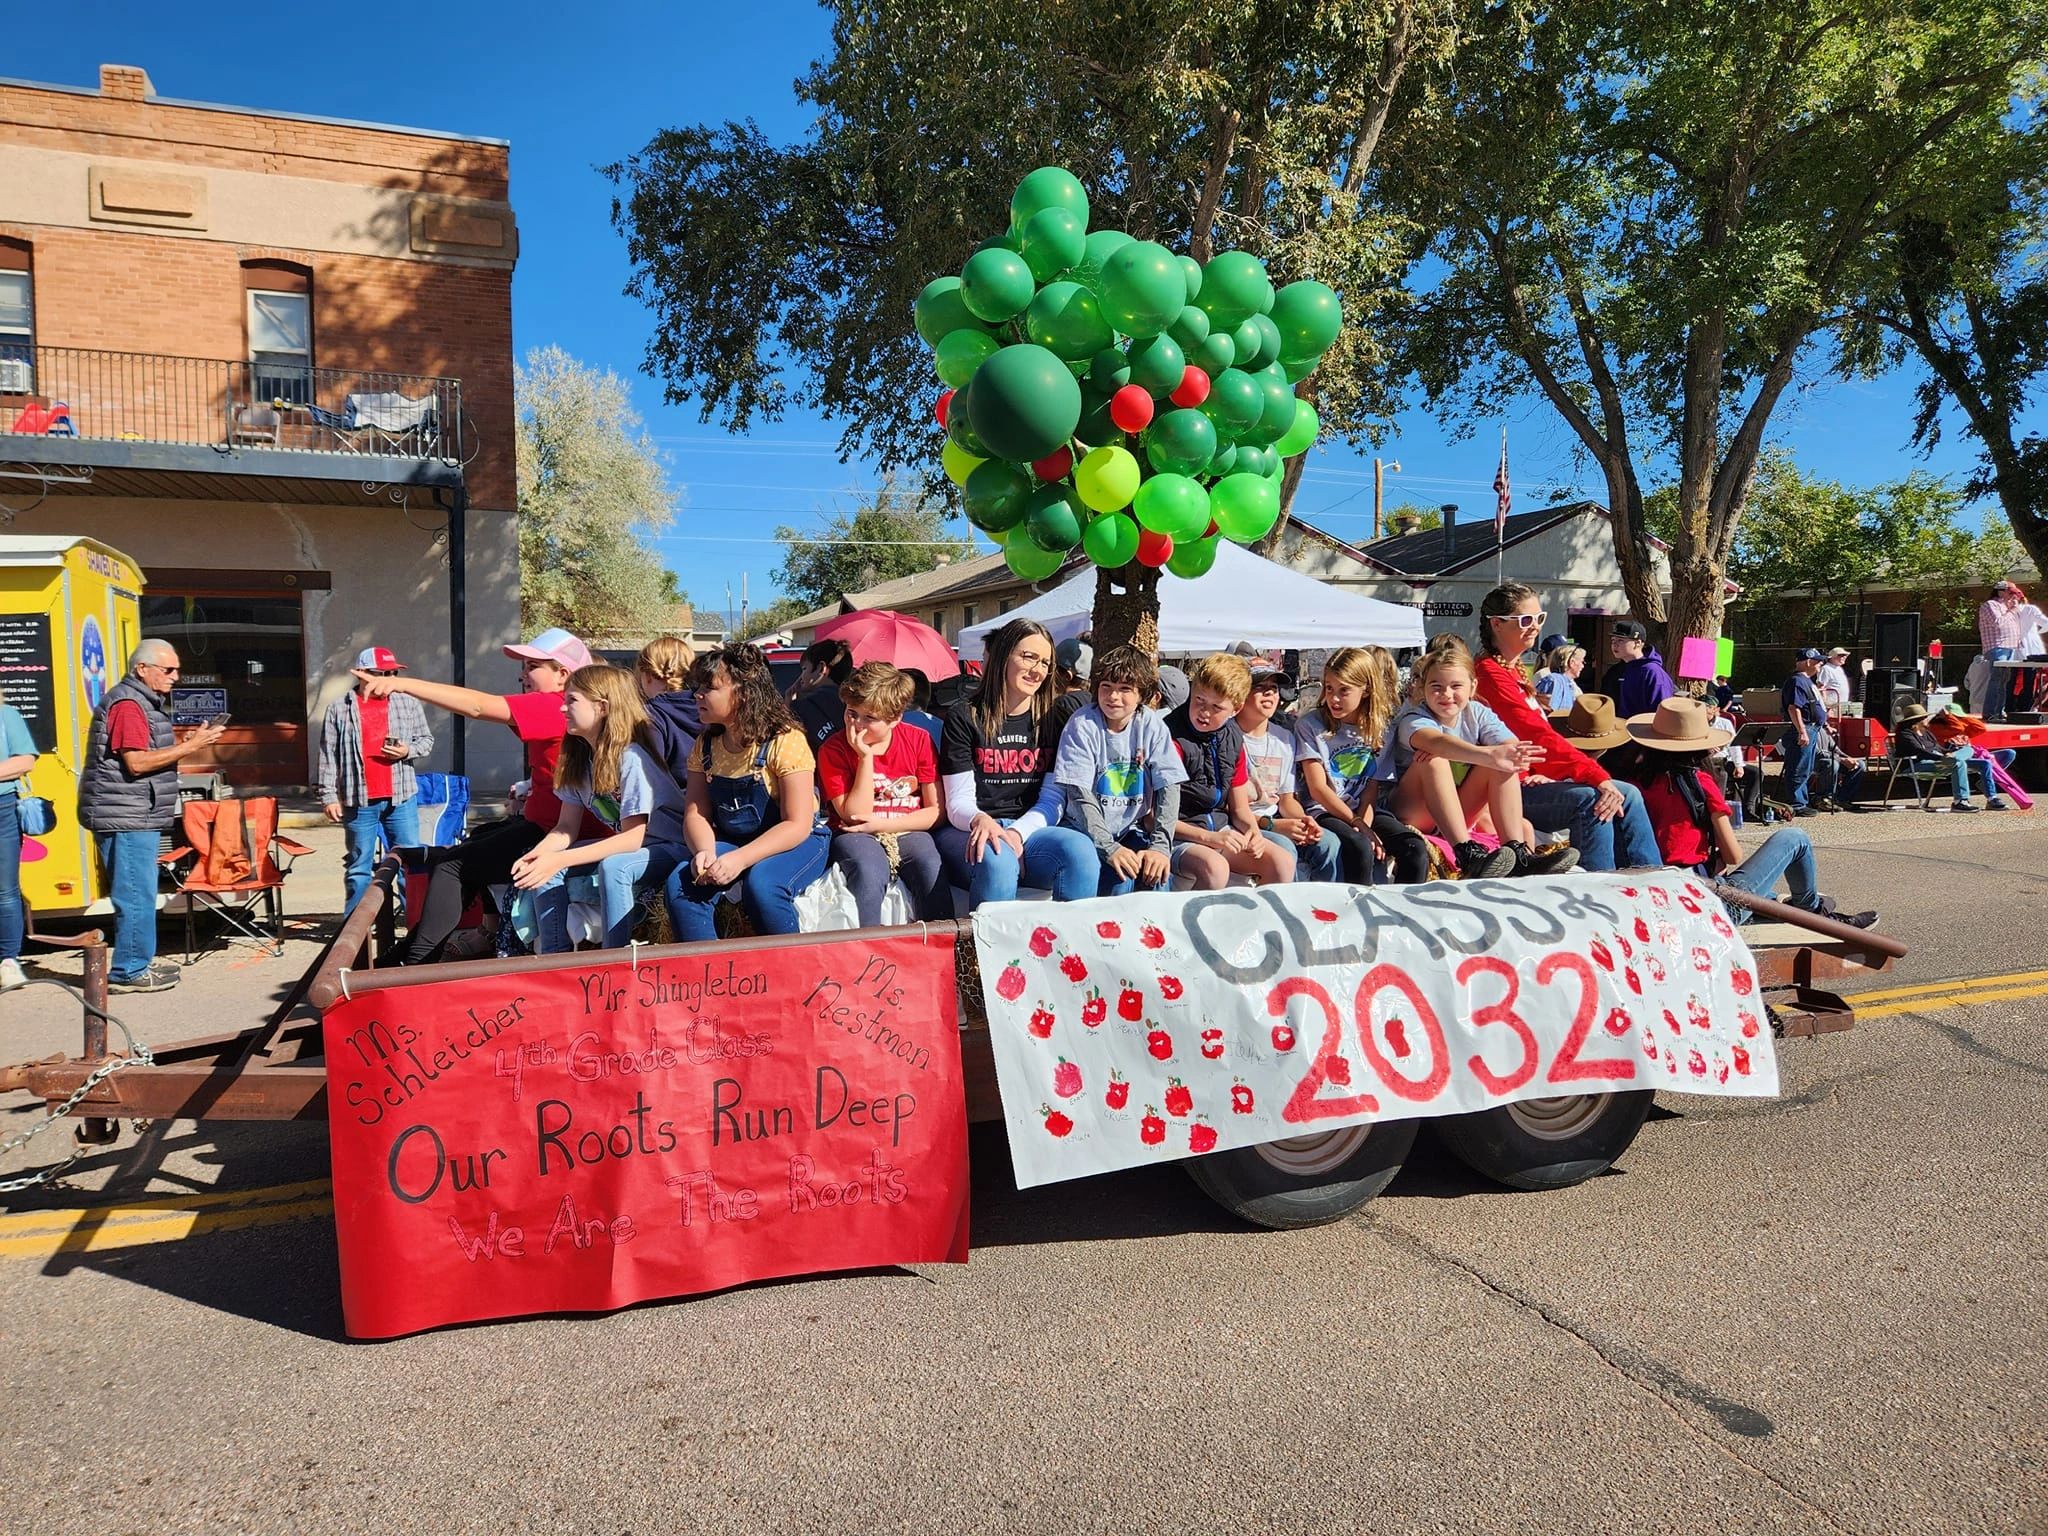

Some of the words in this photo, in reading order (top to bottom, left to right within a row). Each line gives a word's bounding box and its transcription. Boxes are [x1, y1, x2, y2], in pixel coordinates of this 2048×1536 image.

[87, 549, 110, 577] SHAVED
[111, 559, 121, 581] ICE
[174, 700, 196, 709] PRIME
[198, 700, 224, 709] REALTY
[181, 675, 215, 684] OFFICE
[997, 734, 1028, 745] BEAVERS
[1182, 880, 1566, 985] CLASS
[578, 970, 627, 1015] Mr.
[638, 960, 768, 1014] Shingleton
[853, 954, 905, 1010] Ms.
[346, 1020, 423, 1067] Ms.
[346, 996, 526, 1125] Schleicher
[494, 1038, 558, 1102] 4th
[566, 1027, 677, 1083] Grade
[686, 1014, 774, 1066] Class
[1266, 951, 1636, 1124] 2032
[387, 1124, 507, 1204] Our
[536, 1091, 677, 1176] Roots
[713, 1077, 793, 1147] Run
[816, 1066, 916, 1147] Deep
[447, 1211, 526, 1263] We
[544, 1193, 637, 1255] Are
[665, 1169, 760, 1228] The
[788, 1148, 909, 1215] Roots
